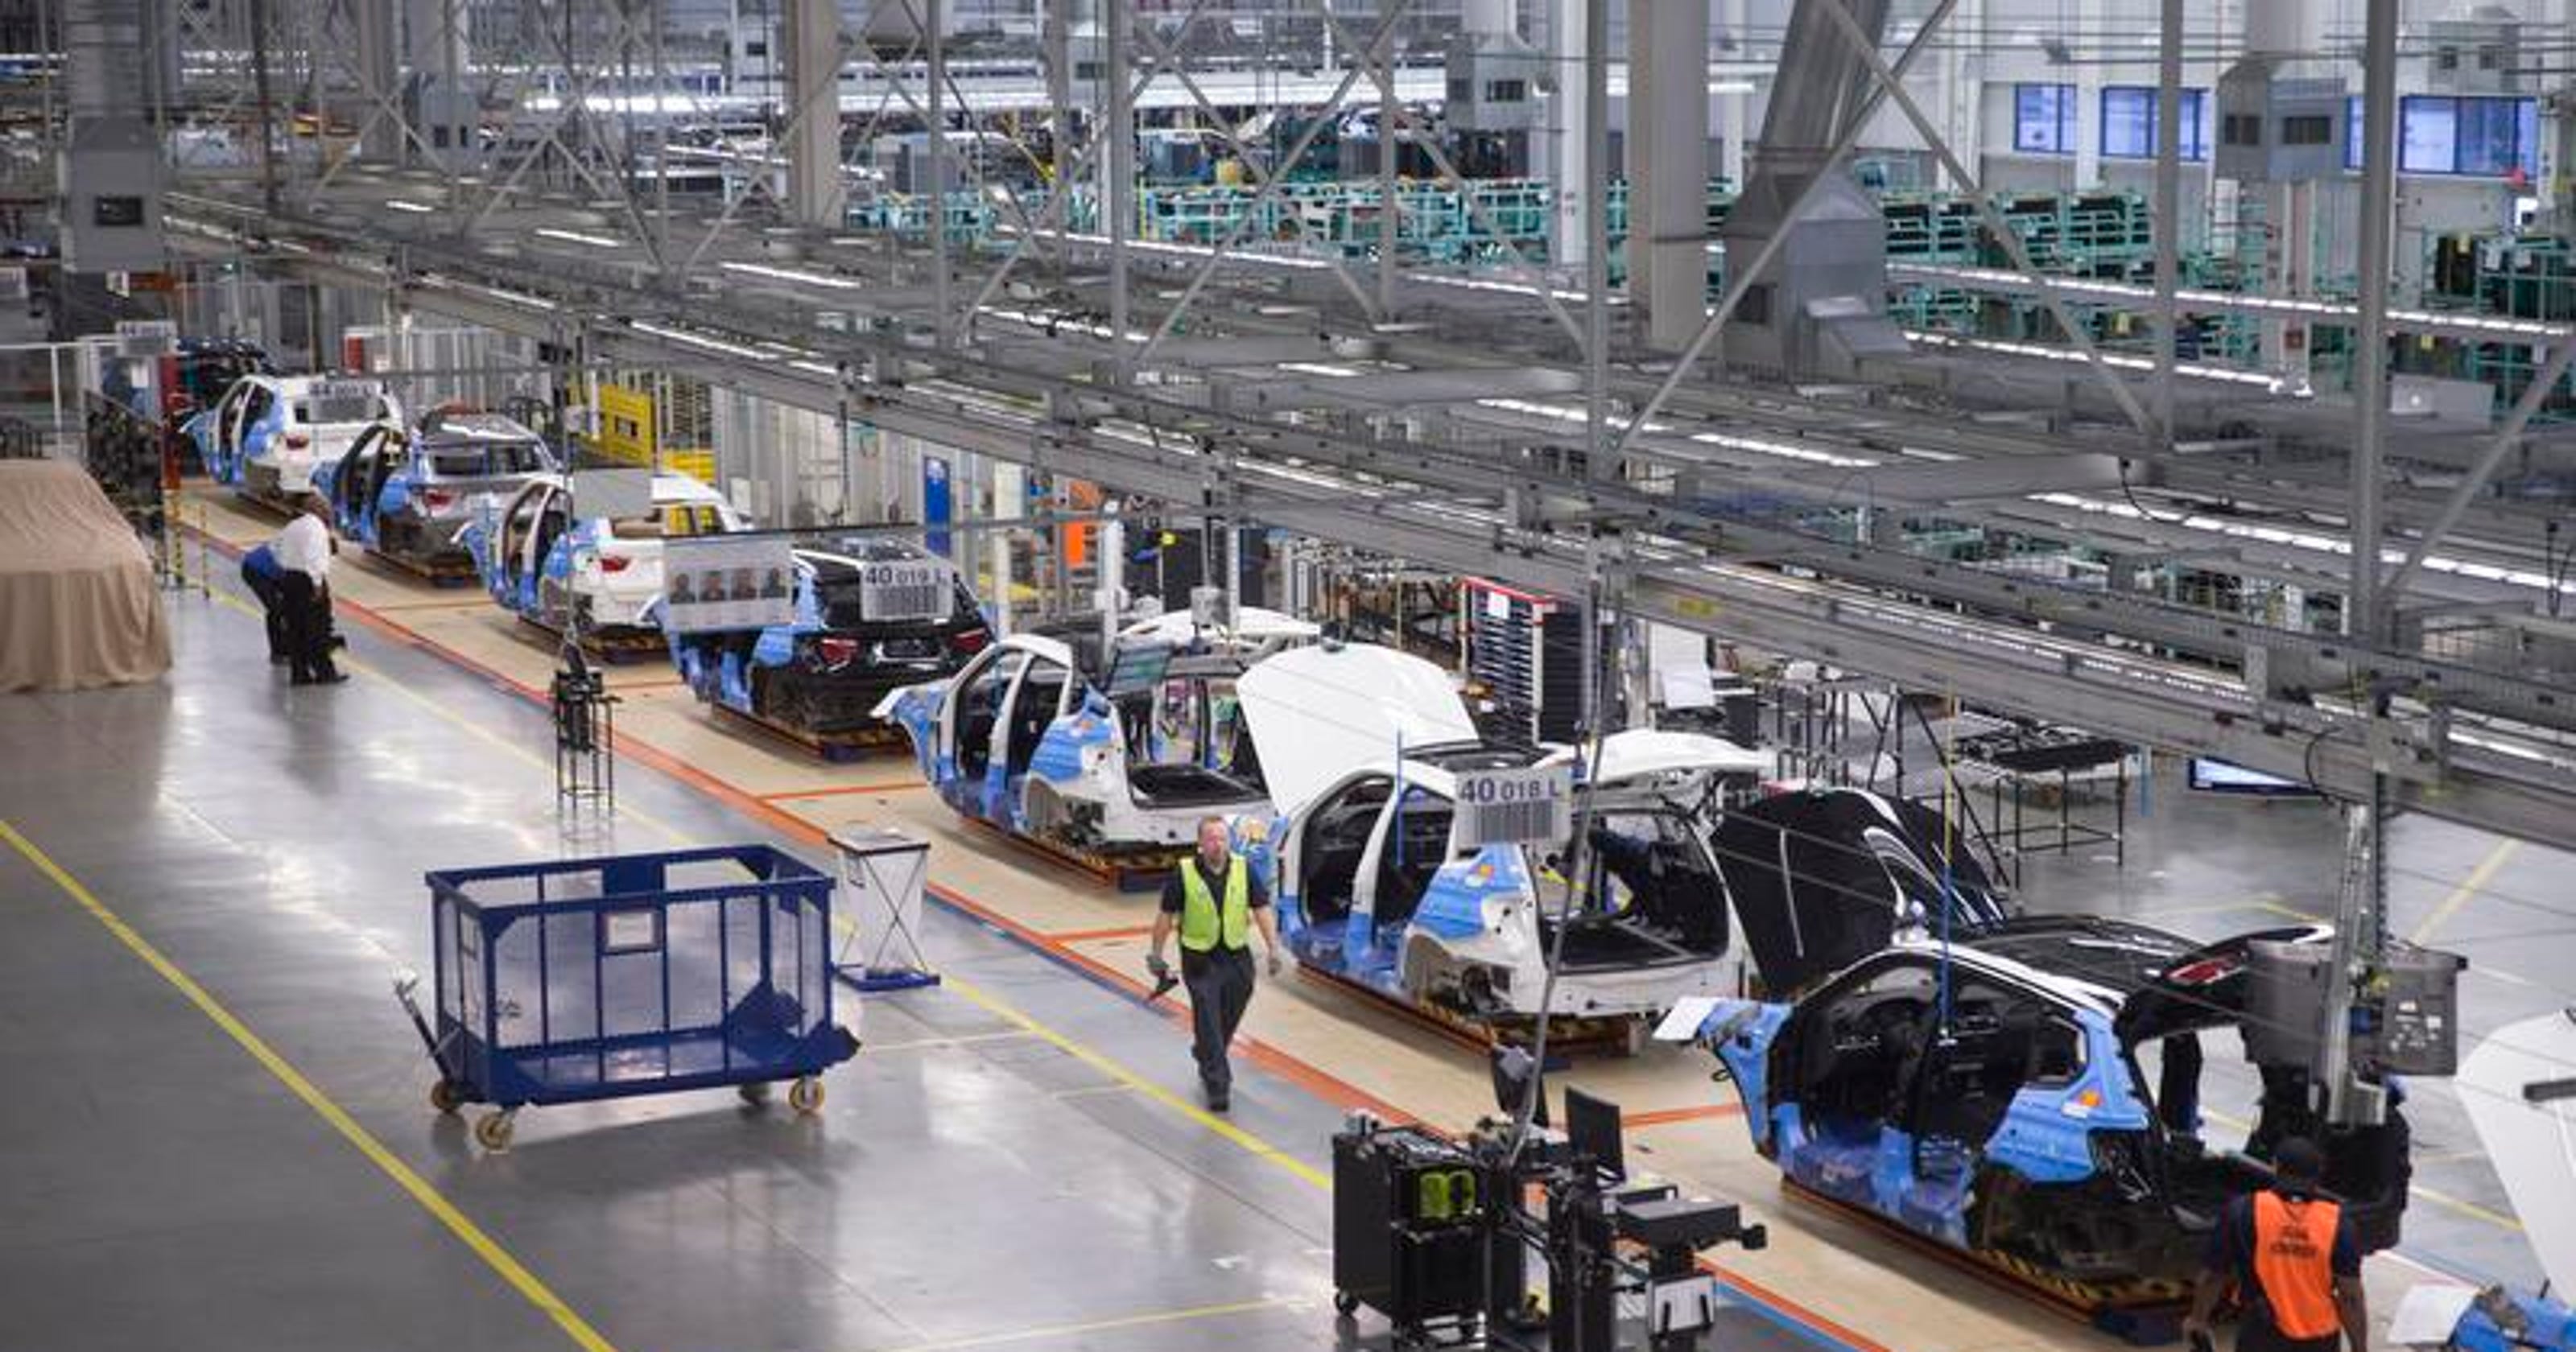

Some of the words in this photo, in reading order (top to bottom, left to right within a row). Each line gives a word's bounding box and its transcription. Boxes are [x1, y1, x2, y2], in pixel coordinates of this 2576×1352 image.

[865, 566, 893, 584] 40
[1459, 777, 1495, 802] 40
[1501, 780, 1541, 800] 018
[1548, 777, 1560, 797] L
